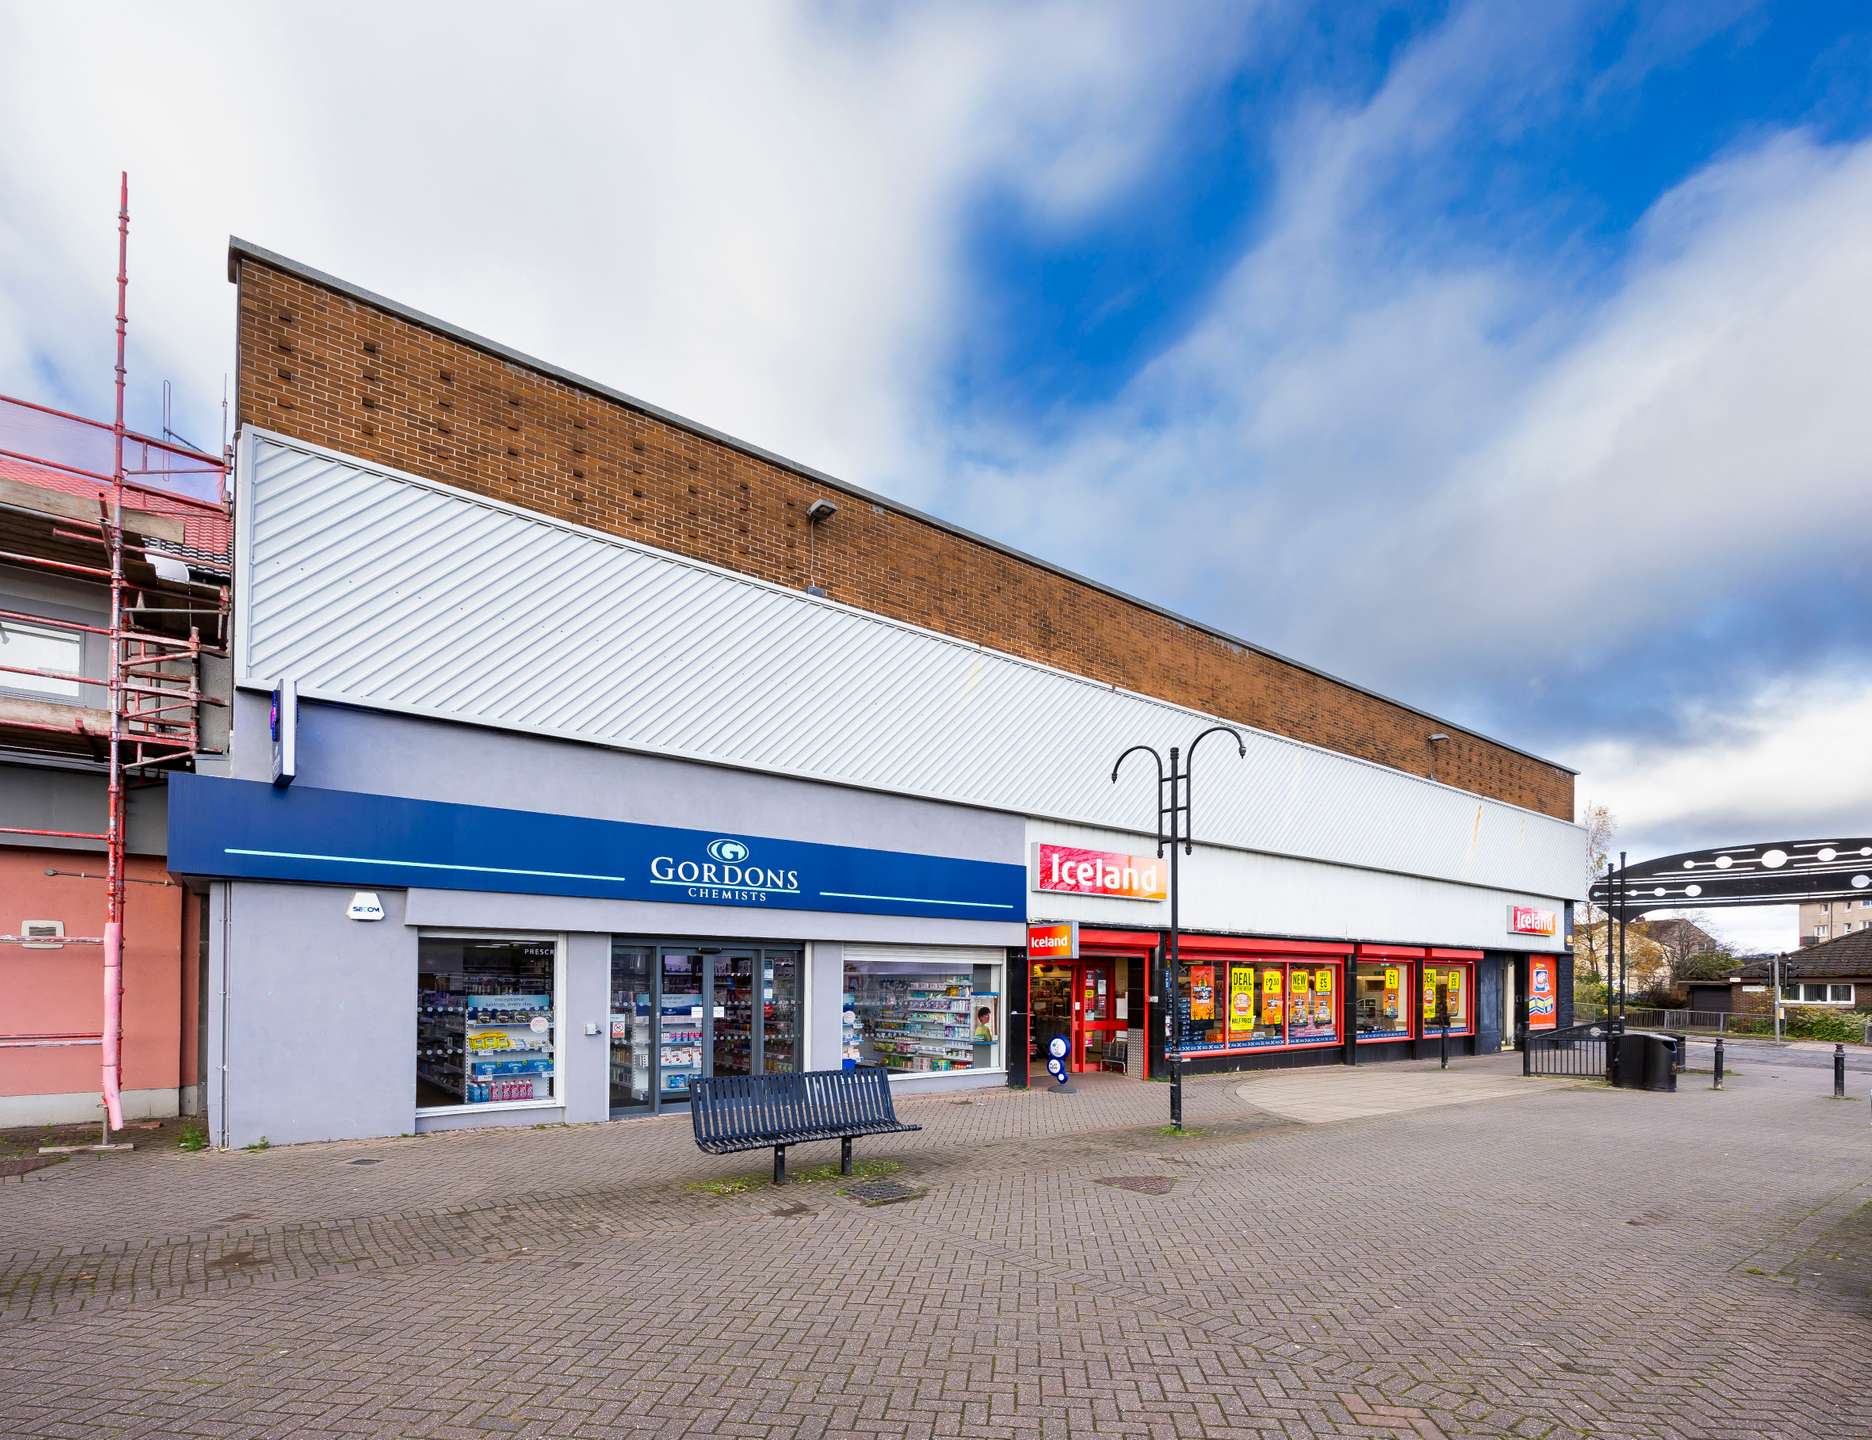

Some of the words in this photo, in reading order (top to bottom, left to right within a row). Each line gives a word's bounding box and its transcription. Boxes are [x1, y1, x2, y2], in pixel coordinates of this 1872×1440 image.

[650, 856, 798, 889] GORDONS
[1052, 853, 1157, 891] Iceland
[688, 887, 766, 902] CHEMISTS
[1517, 911, 1552, 931] Iceland
[1031, 935, 1068, 948] Iceland
[1233, 972, 1252, 986] DEAL
[1292, 973, 1306, 985] NEW
